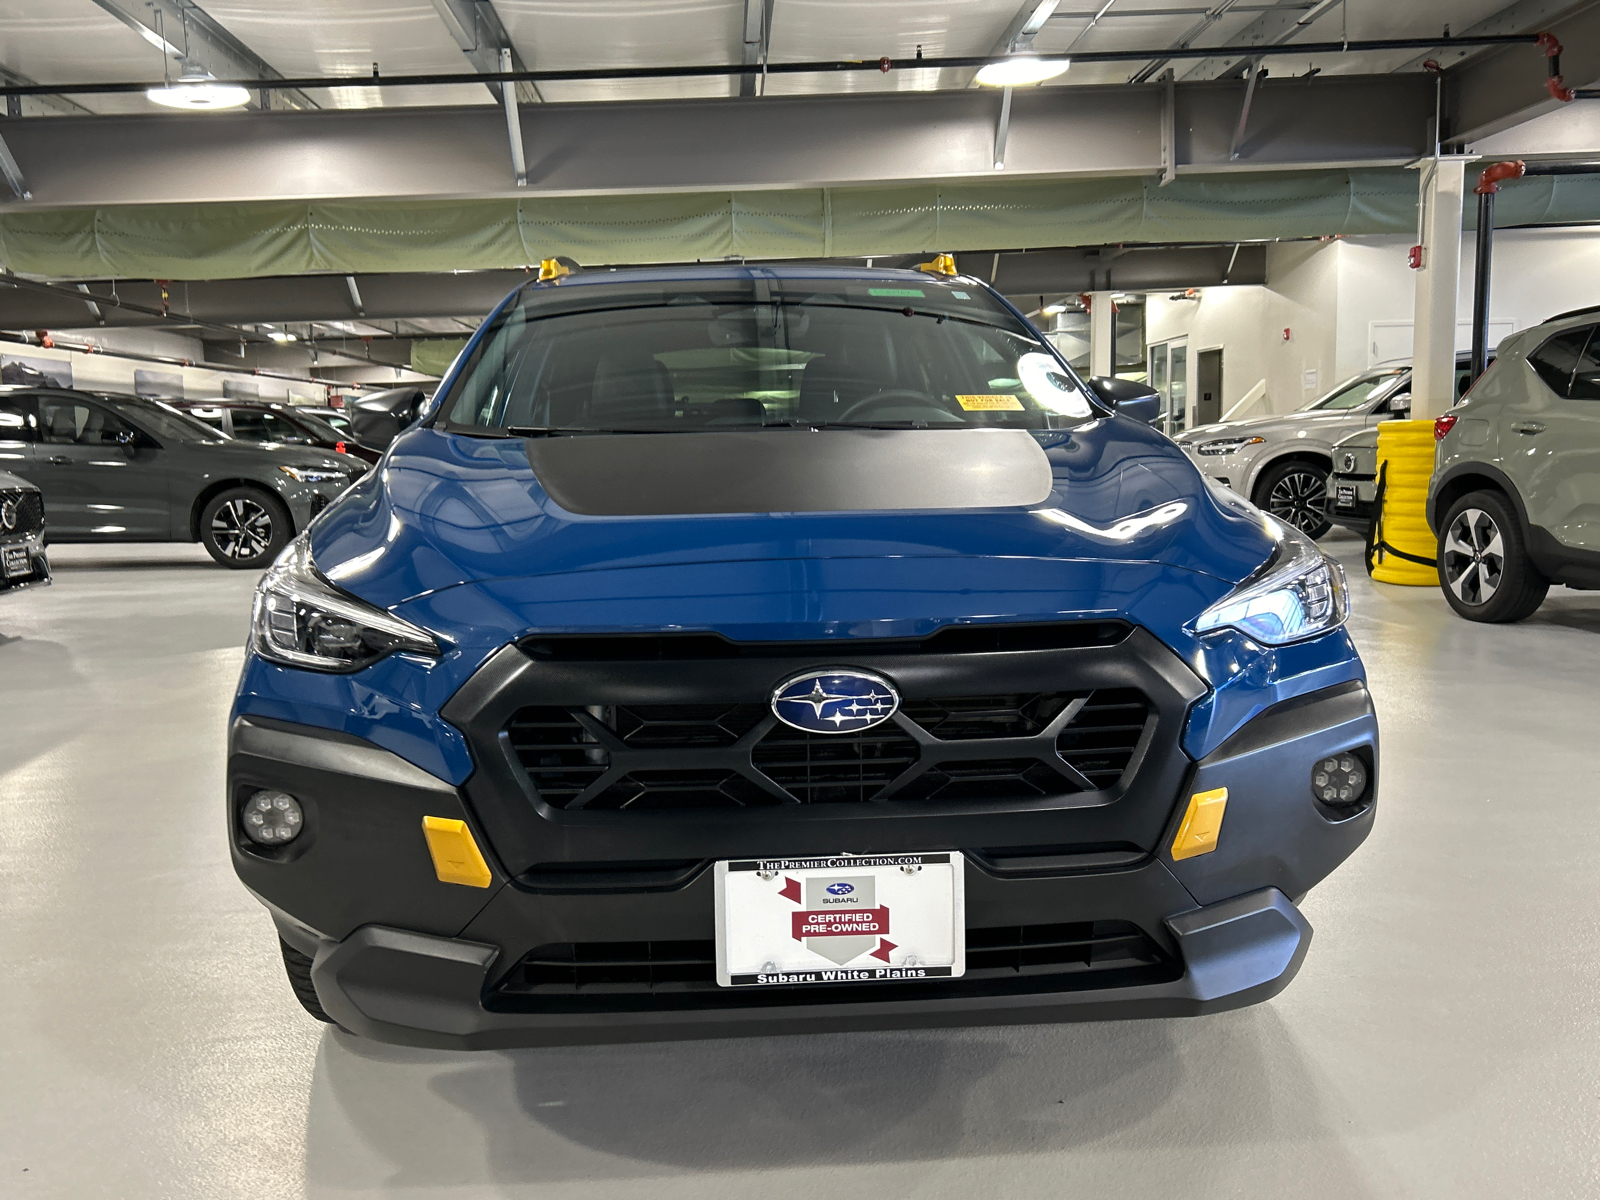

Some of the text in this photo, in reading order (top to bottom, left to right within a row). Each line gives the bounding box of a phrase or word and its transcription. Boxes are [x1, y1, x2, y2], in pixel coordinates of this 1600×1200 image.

[808, 913, 873, 923] CERTIFIED
[802, 923, 879, 933] PRE-OWNED
[757, 968, 926, 983] Subaru White Plains
